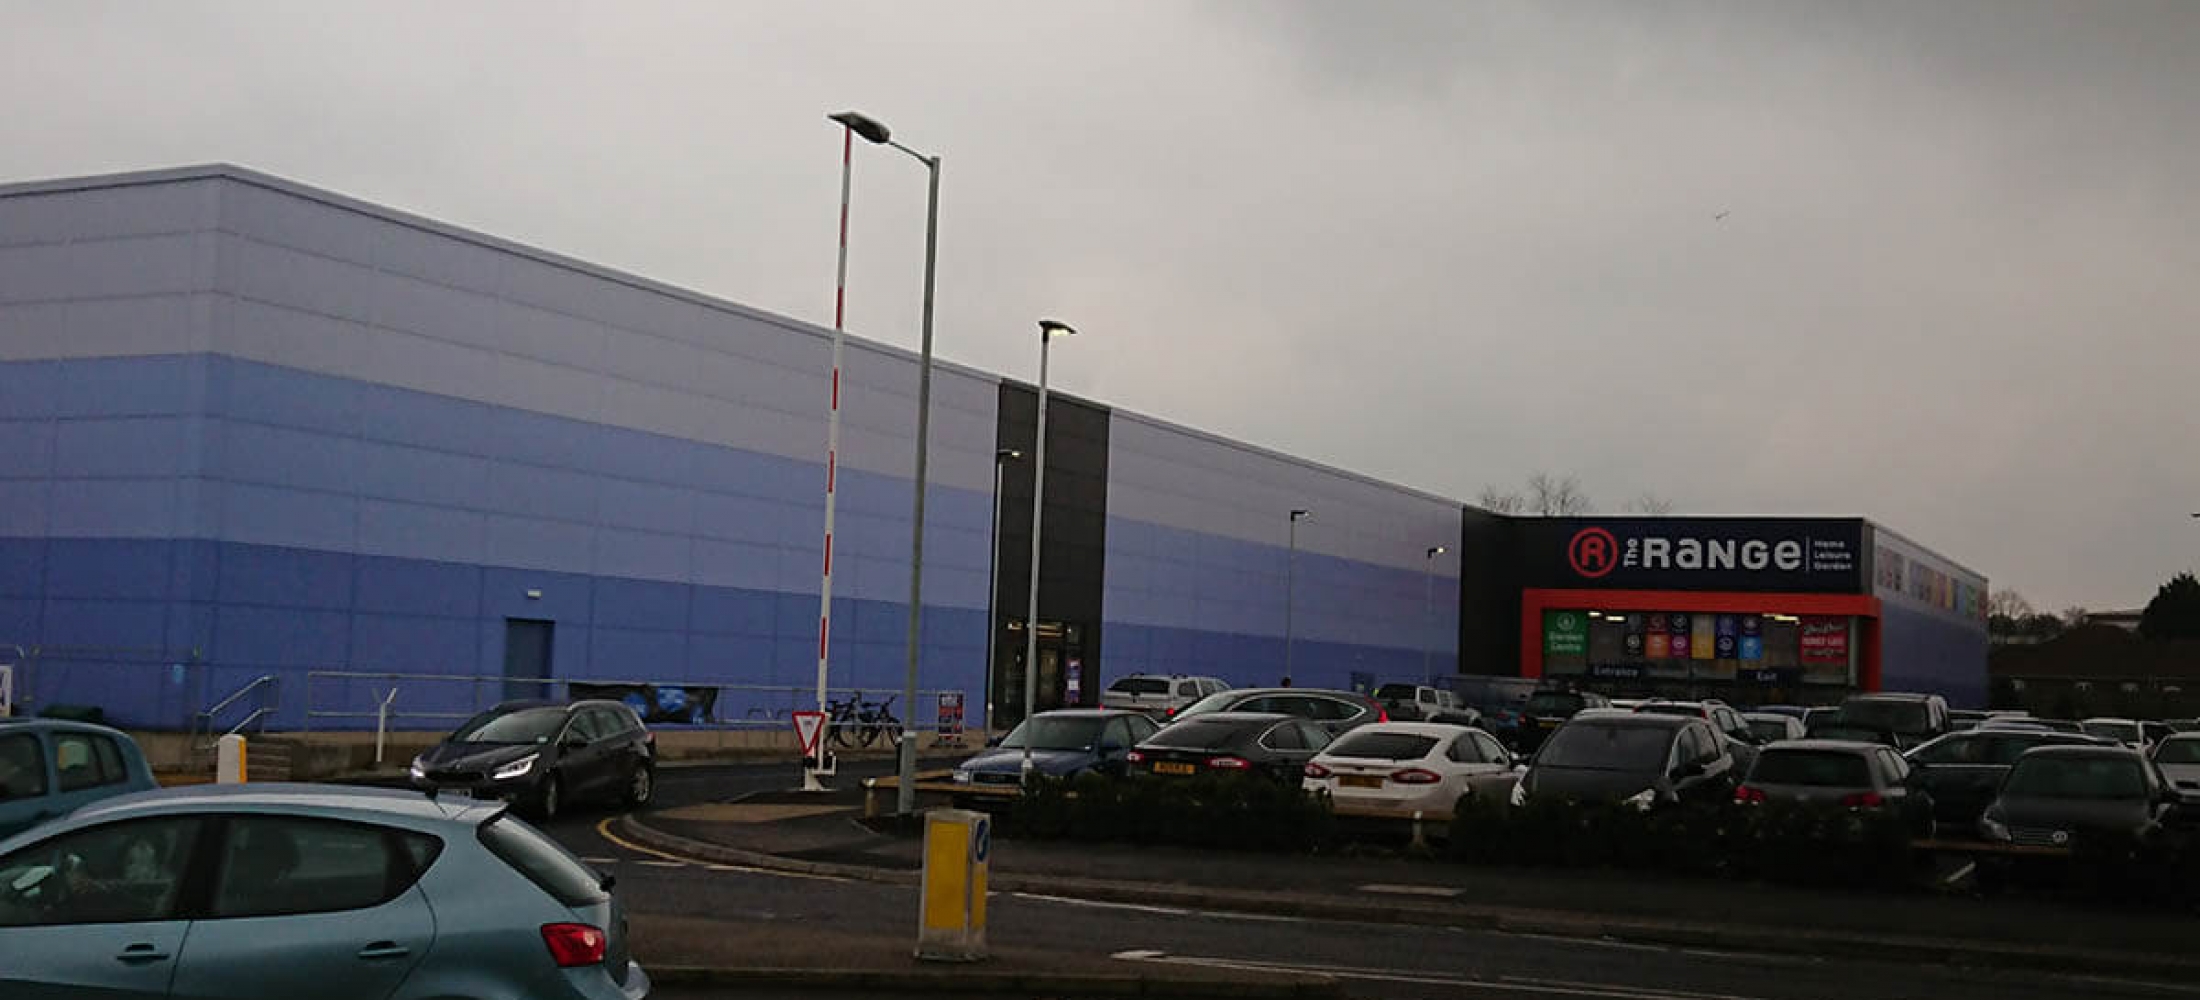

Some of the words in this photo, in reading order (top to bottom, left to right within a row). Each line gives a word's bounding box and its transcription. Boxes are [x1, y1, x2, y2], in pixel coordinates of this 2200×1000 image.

[1624, 538, 1638, 568] The
[1815, 550, 1850, 559] Leisure
[1815, 561, 1852, 572] Garden
[1549, 631, 1584, 642] Garden
[1550, 642, 1582, 651] Centre
[1593, 666, 1638, 677] Entrance
[1757, 671, 1777, 681] Exit
